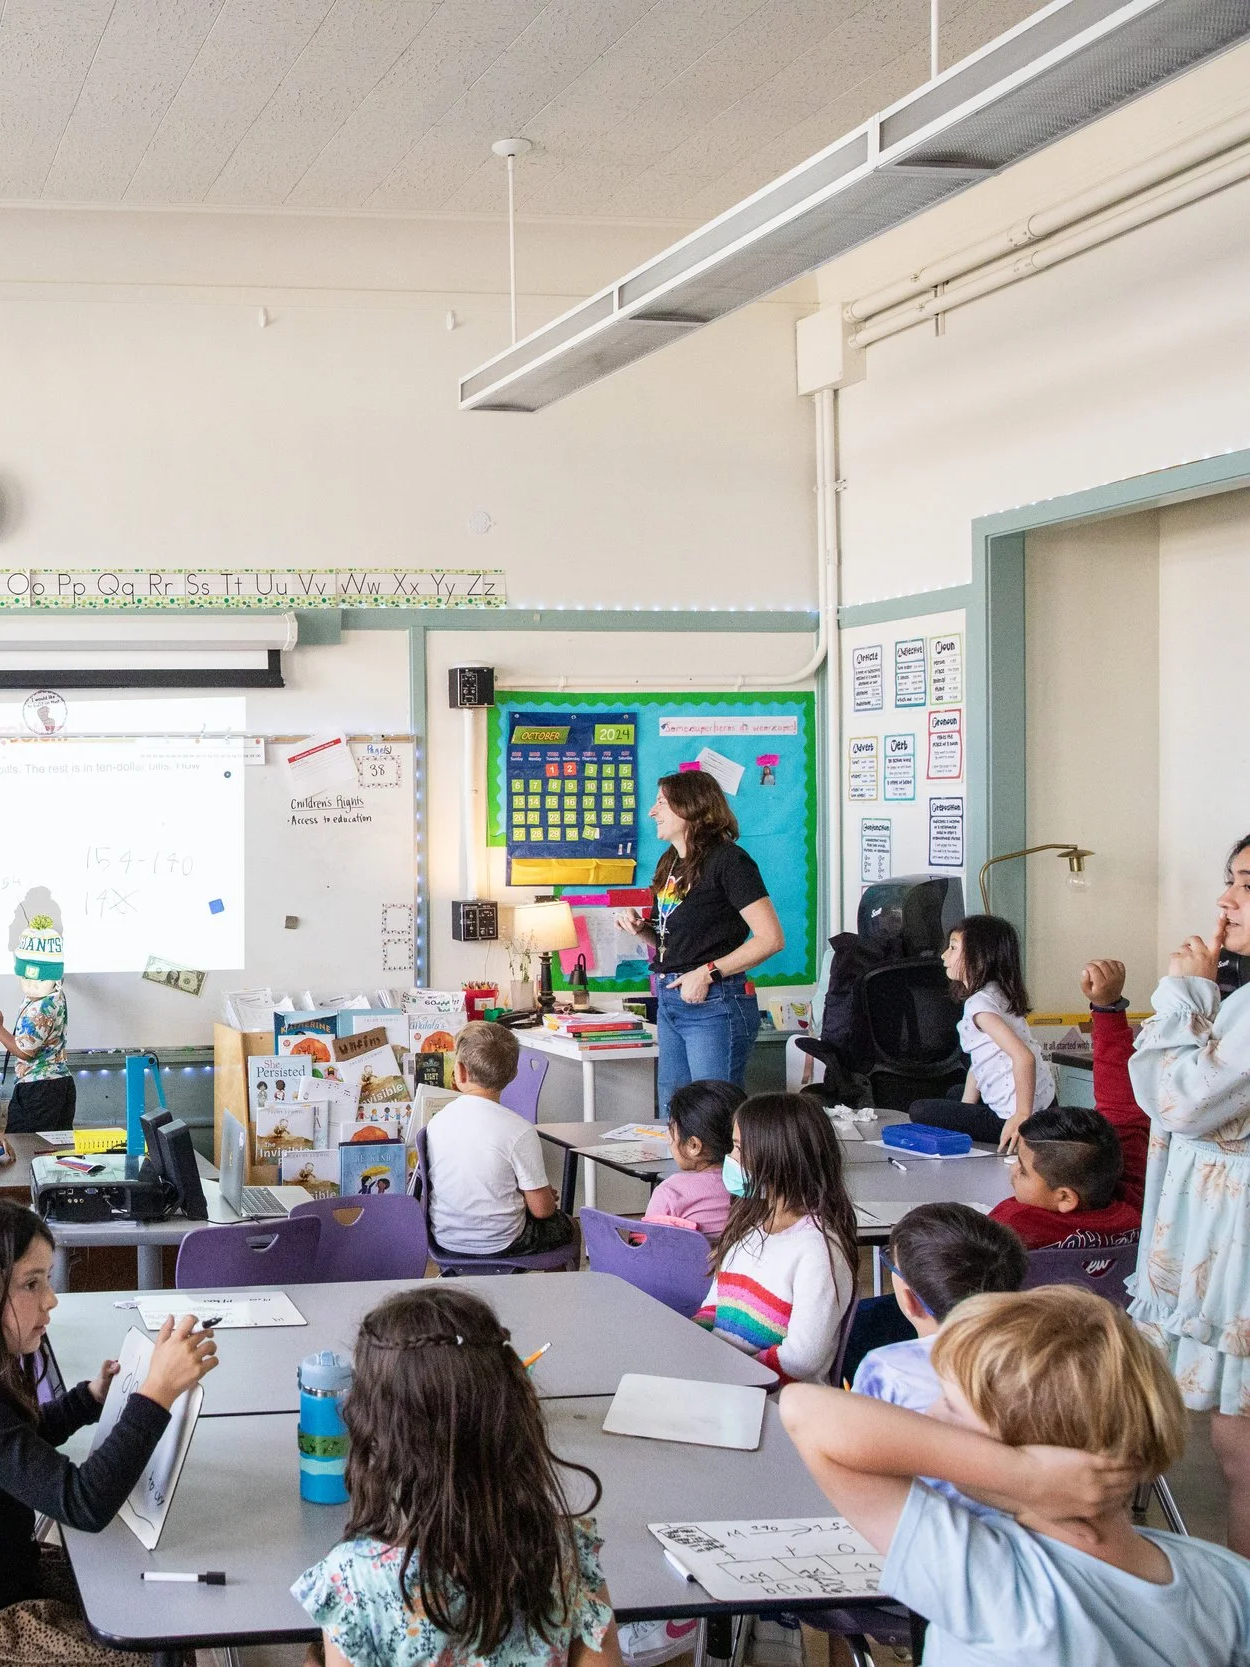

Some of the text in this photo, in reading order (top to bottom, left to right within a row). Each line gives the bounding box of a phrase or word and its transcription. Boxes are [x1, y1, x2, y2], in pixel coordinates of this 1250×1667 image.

[7, 573, 45, 596] Oo
[58, 573, 86, 604] Pp
[97, 573, 135, 604] Qq
[149, 573, 173, 596] Rr
[186, 573, 210, 596] Ss
[220, 573, 242, 596] Tt
[255, 573, 287, 596] Uu
[298, 573, 327, 596] Vv
[341, 573, 381, 596] Ww
[393, 573, 420, 596] Xx
[430, 573, 456, 605] Yy
[467, 573, 496, 596] Zz
[521, 728, 630, 741] OCTOBER 2024
[26, 763, 46, 774] The
[48, 763, 69, 773] rest
[71, 762, 80, 772] is
[83, 762, 93, 772] in
[370, 763, 385, 777] 38
[567, 765, 572, 773] 2
[588, 766, 593, 774] 3
[336, 795, 364, 813] Rights
[292, 813, 372, 825] Access to education
[1057, 1041, 1076, 1050] started
[264, 1060, 281, 1069] She
[256, 1065, 306, 1078] Persisted
